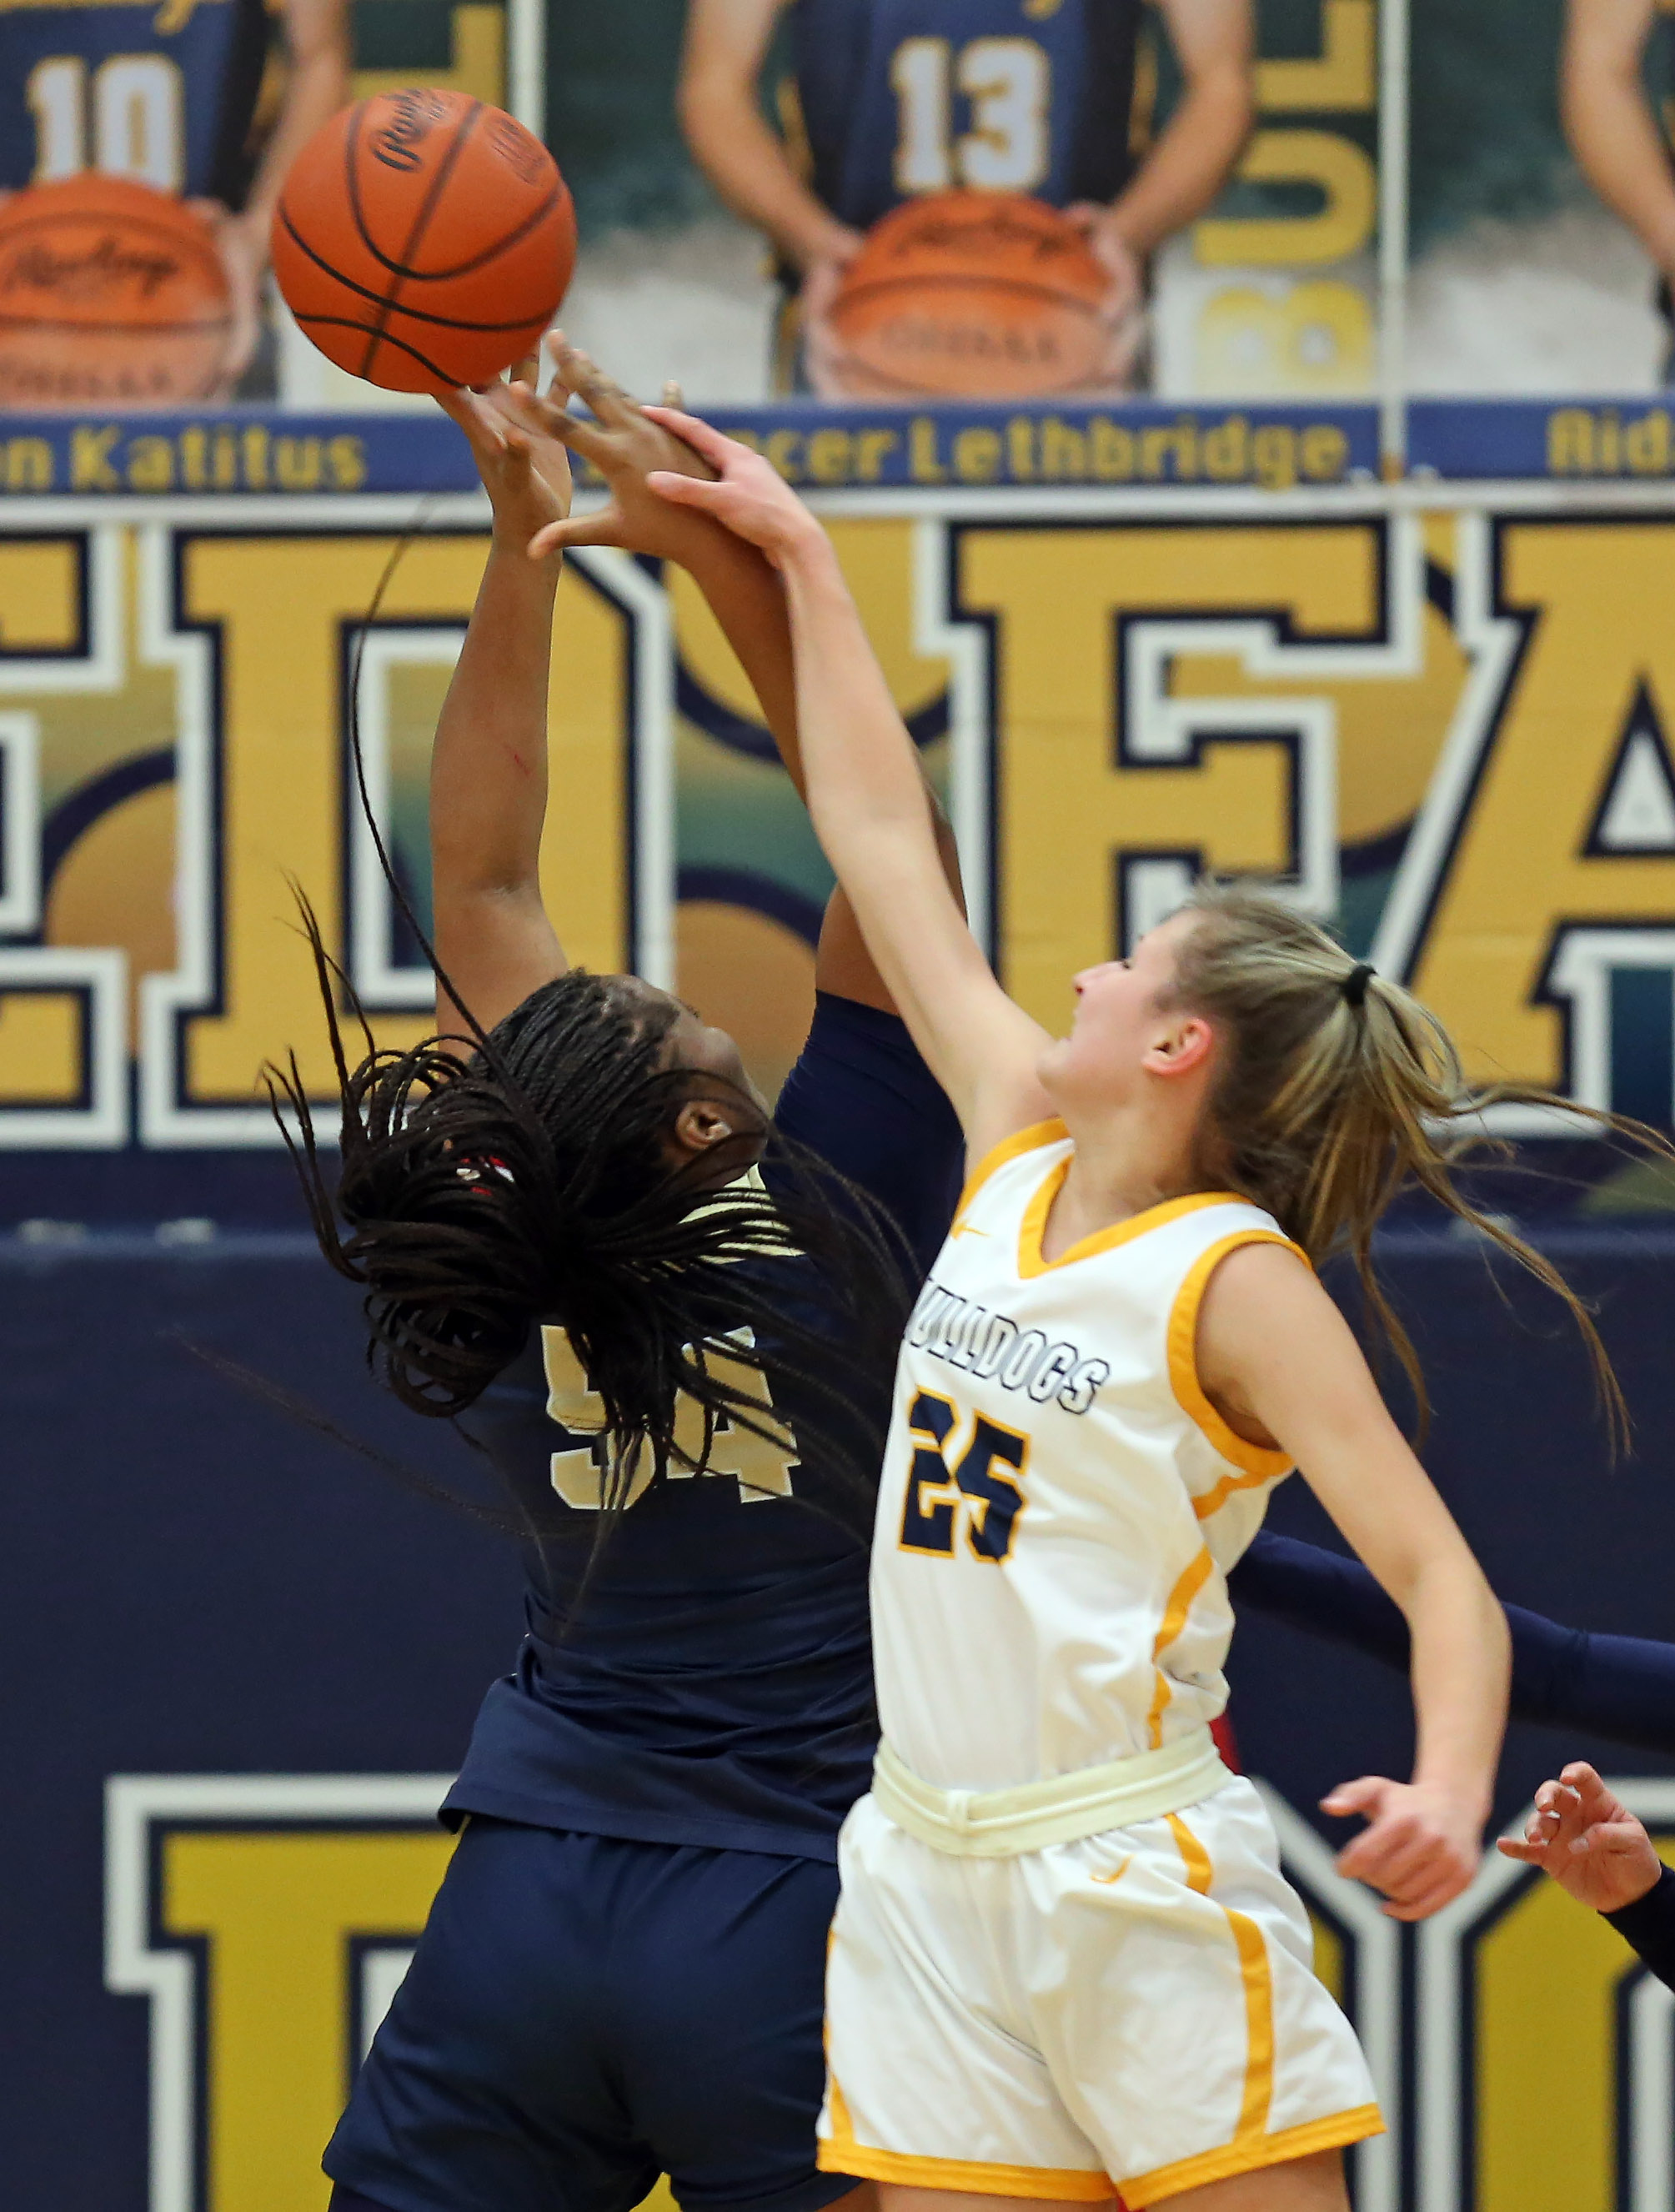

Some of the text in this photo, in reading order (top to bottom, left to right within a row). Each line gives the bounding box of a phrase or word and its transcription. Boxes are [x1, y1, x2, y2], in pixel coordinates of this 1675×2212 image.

[28, 54, 183, 193] 10
[892, 37, 1051, 194] 13
[0, 435, 53, 490] n
[910, 416, 1348, 491] Lethbridge
[907, 1276, 1110, 1415] ULLDOGS
[898, 1384, 1031, 1565] 25
